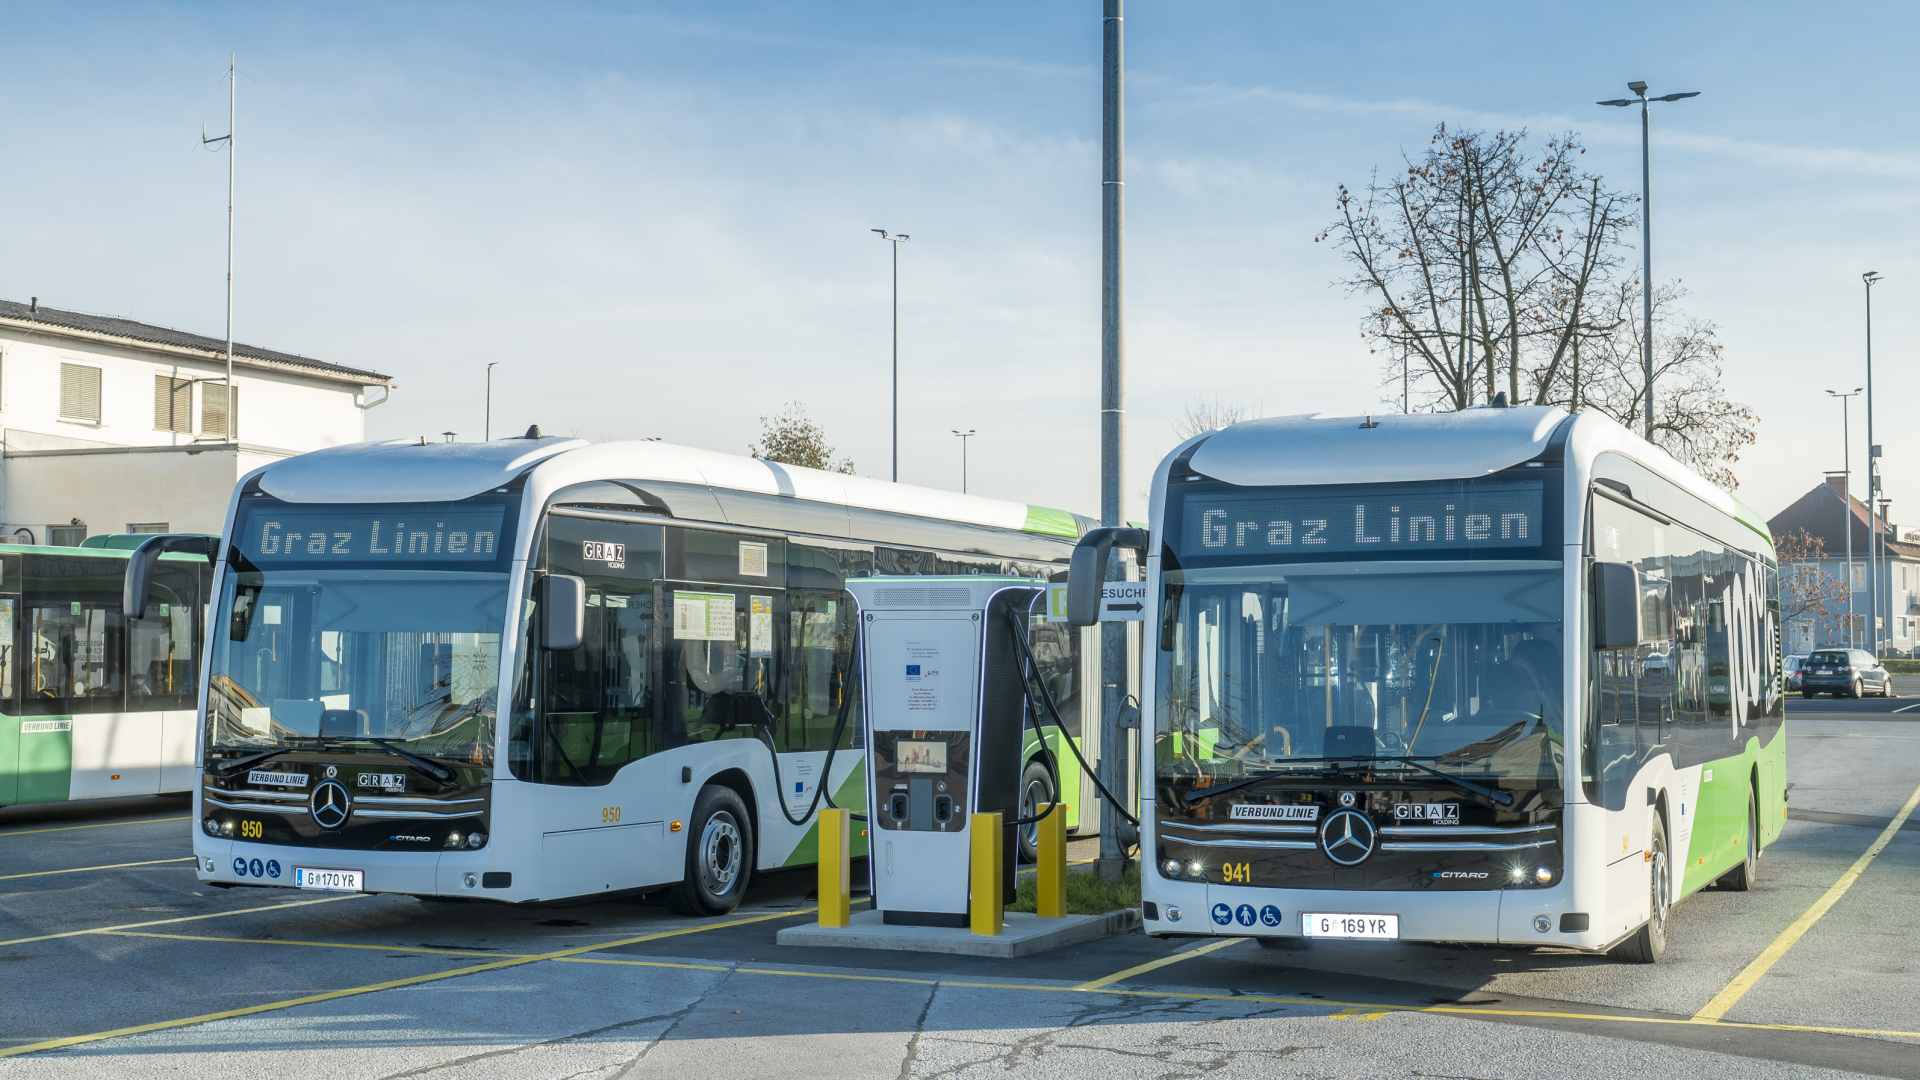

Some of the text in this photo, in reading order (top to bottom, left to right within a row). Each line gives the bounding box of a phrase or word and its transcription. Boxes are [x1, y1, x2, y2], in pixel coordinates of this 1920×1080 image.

[1203, 504, 1528, 547] Graz Linien
[260, 520, 494, 554] Graz Linien
[585, 543, 623, 560] GRAZ
[1101, 588, 1146, 599] ESUCH
[24, 721, 70, 731] VERBUND LINIE
[251, 772, 305, 785] VERBUND LINIE
[359, 774, 403, 786] GRAZ
[602, 806, 621, 823] 950
[1235, 806, 1315, 819] VERBUND LINIE
[1396, 805, 1456, 818] GRAZ
[241, 819, 263, 838] 950
[308, 872, 355, 887] G 170 YR
[1222, 862, 1251, 883] 941
[1433, 871, 1489, 879] eCITARO
[1321, 918, 1387, 934] G 169 YR
